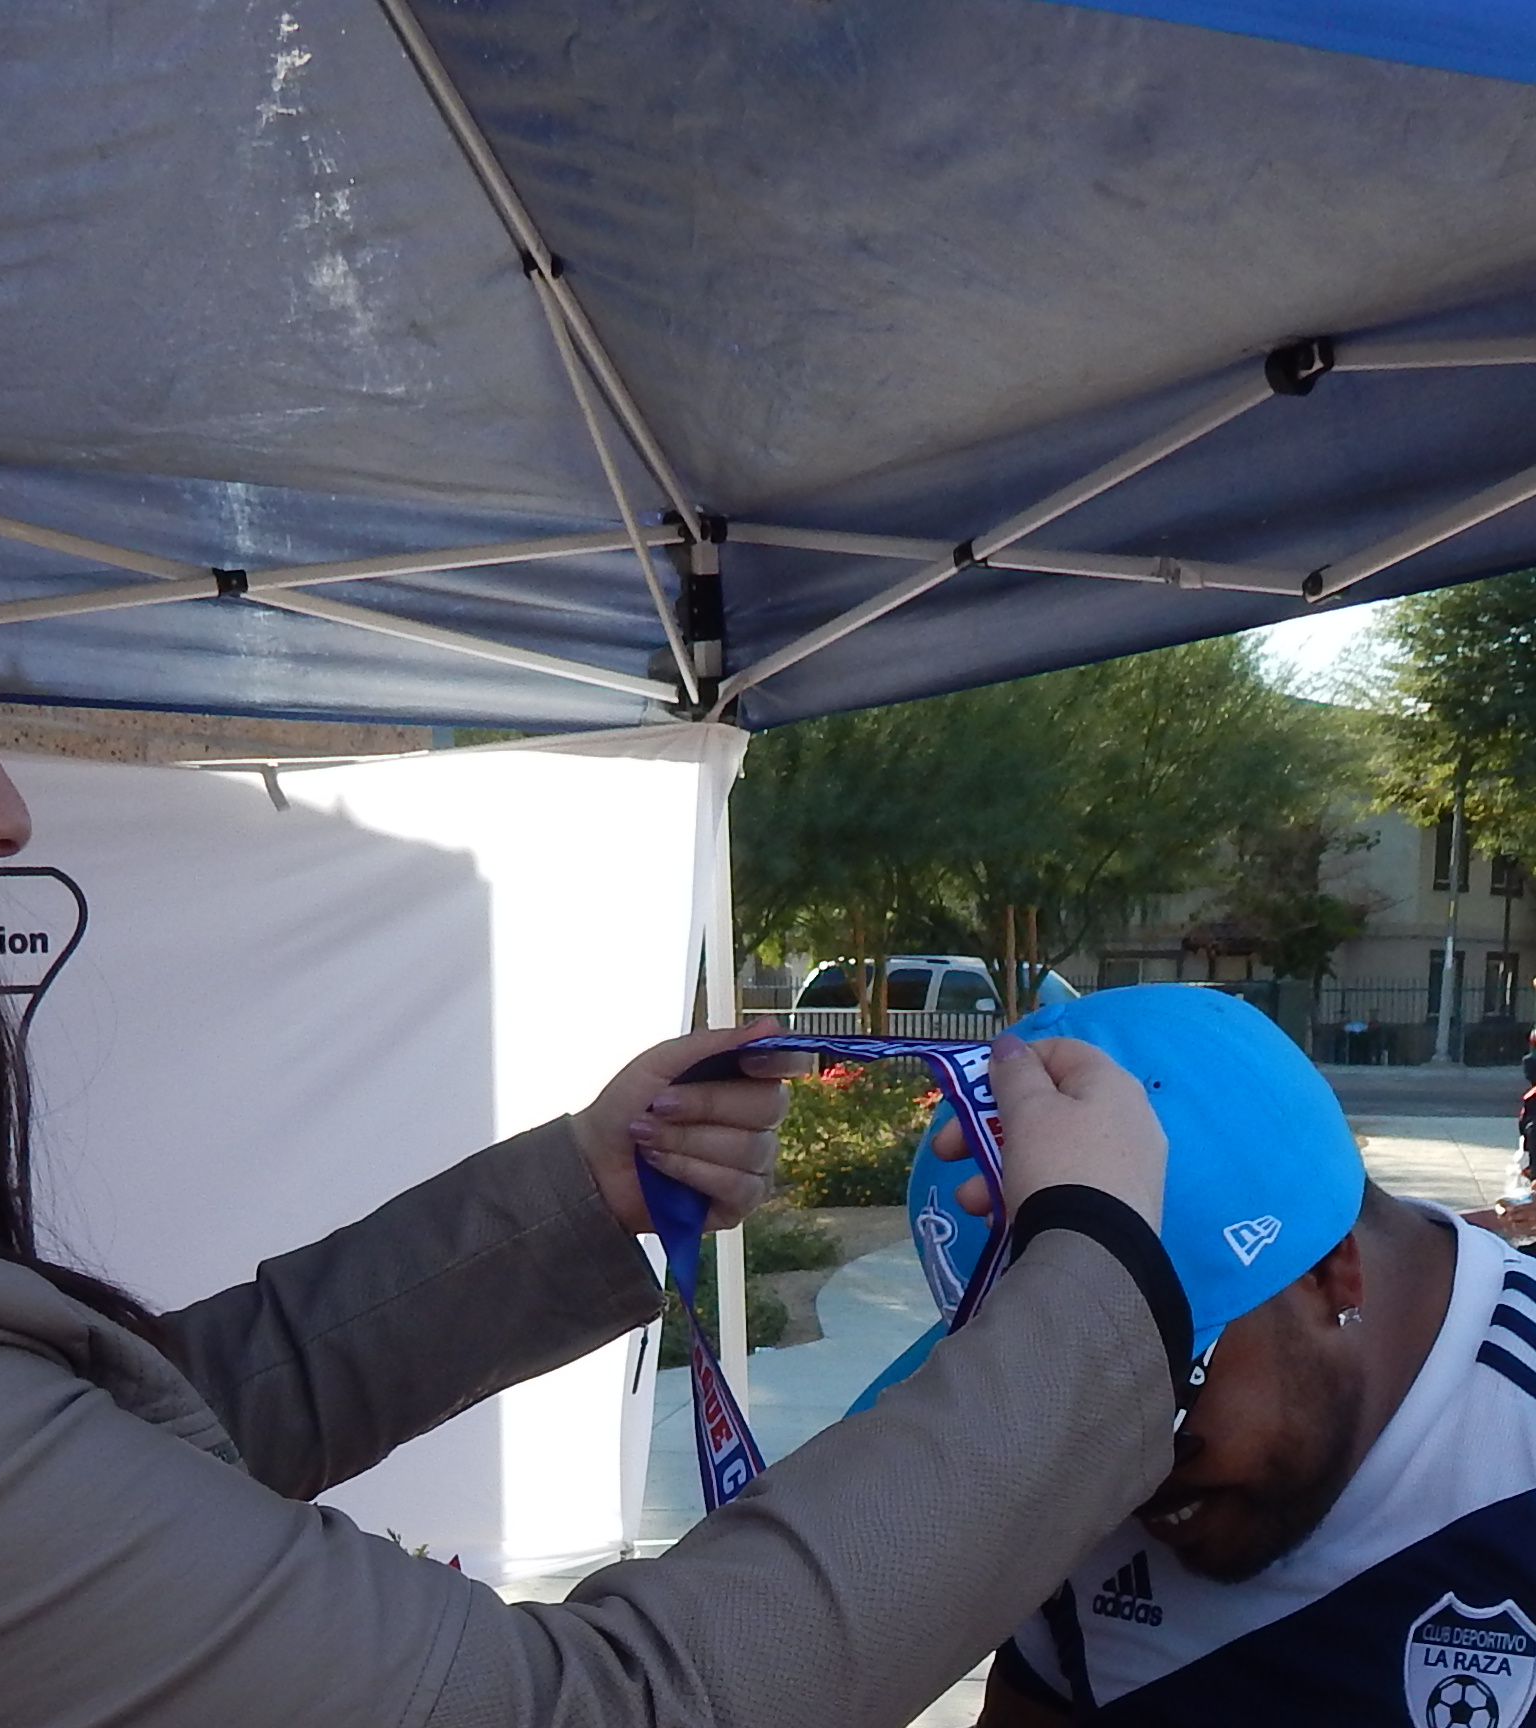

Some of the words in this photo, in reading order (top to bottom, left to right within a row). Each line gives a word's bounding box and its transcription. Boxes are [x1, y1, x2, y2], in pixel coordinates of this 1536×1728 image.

[1092, 1592, 1163, 1627] adidas
[1423, 1624, 1452, 1644] CLUB
[1452, 1627, 1527, 1652] DEPORTIVO
[1424, 1648, 1448, 1668] LA
[1453, 1651, 1512, 1676] RAZA
